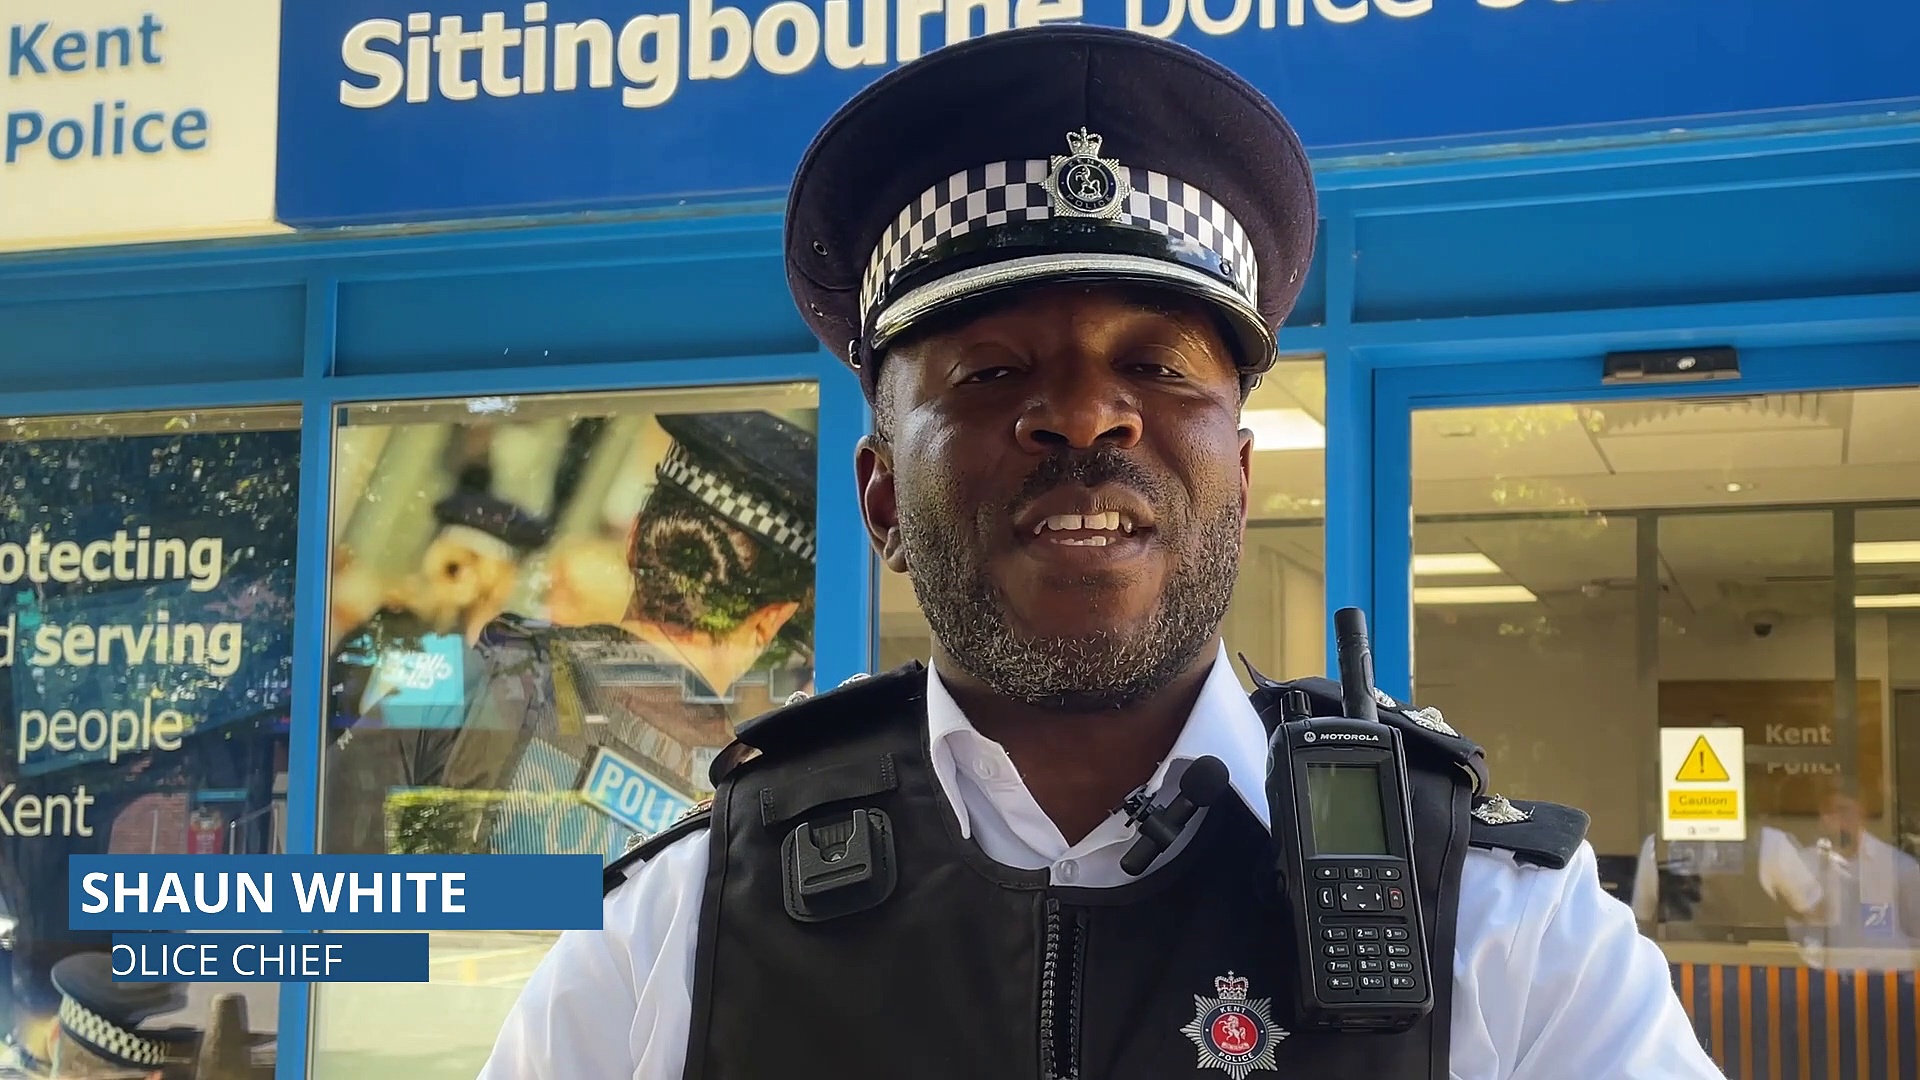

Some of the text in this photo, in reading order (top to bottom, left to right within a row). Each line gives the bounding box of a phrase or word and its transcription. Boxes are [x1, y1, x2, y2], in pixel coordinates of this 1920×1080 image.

[8, 12, 165, 77] Kent
[4, 101, 211, 164] Police
[1067, 194, 1112, 208] POLICE
[34, 609, 243, 677] serving
[18, 696, 184, 764] people
[1766, 723, 1832, 745] Kent
[1320, 733, 1378, 741] MOTOROLA
[593, 761, 688, 831] POLI
[1679, 795, 1728, 806] Caution
[1327, 929, 1333, 938] 1
[1357, 929, 1363, 937] 2
[1386, 929, 1392, 938] 3
[1328, 945, 1335, 954] 4
[1359, 945, 1365, 953] 5
[1388, 945, 1394, 954] 6
[1330, 962, 1336, 970] 7
[1361, 961, 1367, 969] 8
[1389, 961, 1396, 969] 9
[1363, 977, 1369, 986] 0
[1220, 1005, 1246, 1014] KENT
[1218, 1053, 1254, 1062] POLICE
